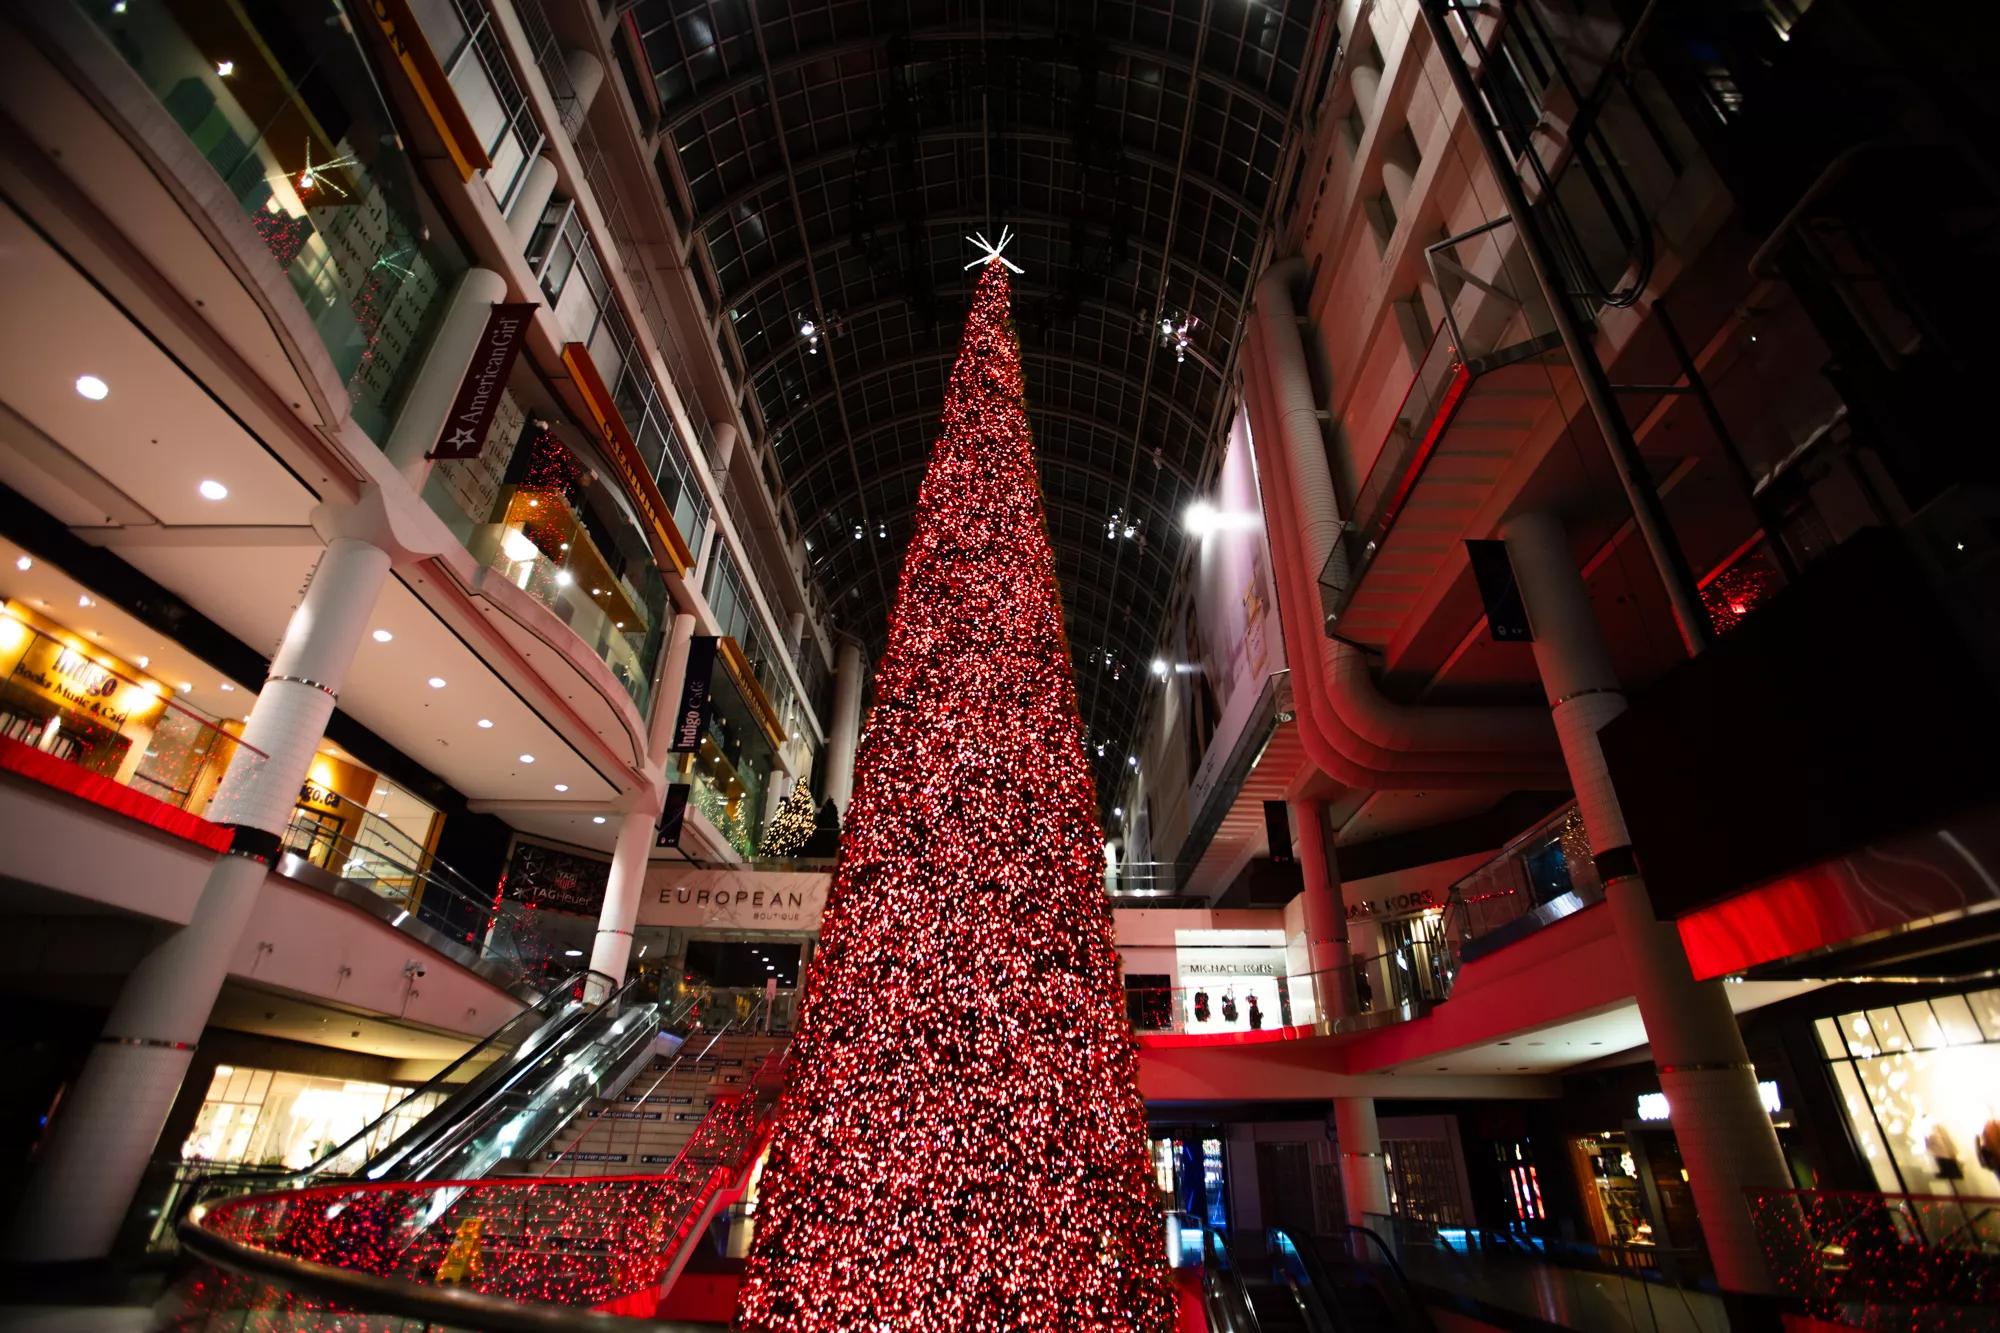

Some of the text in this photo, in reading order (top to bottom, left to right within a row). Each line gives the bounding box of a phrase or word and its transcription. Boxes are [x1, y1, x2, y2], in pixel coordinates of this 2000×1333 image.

[54, 682, 90, 708] Music
[659, 888, 803, 908] EUROPEAN
[753, 912, 799, 921] BOUTIQUE
[1189, 964, 1274, 974] MICHAEL KORS
